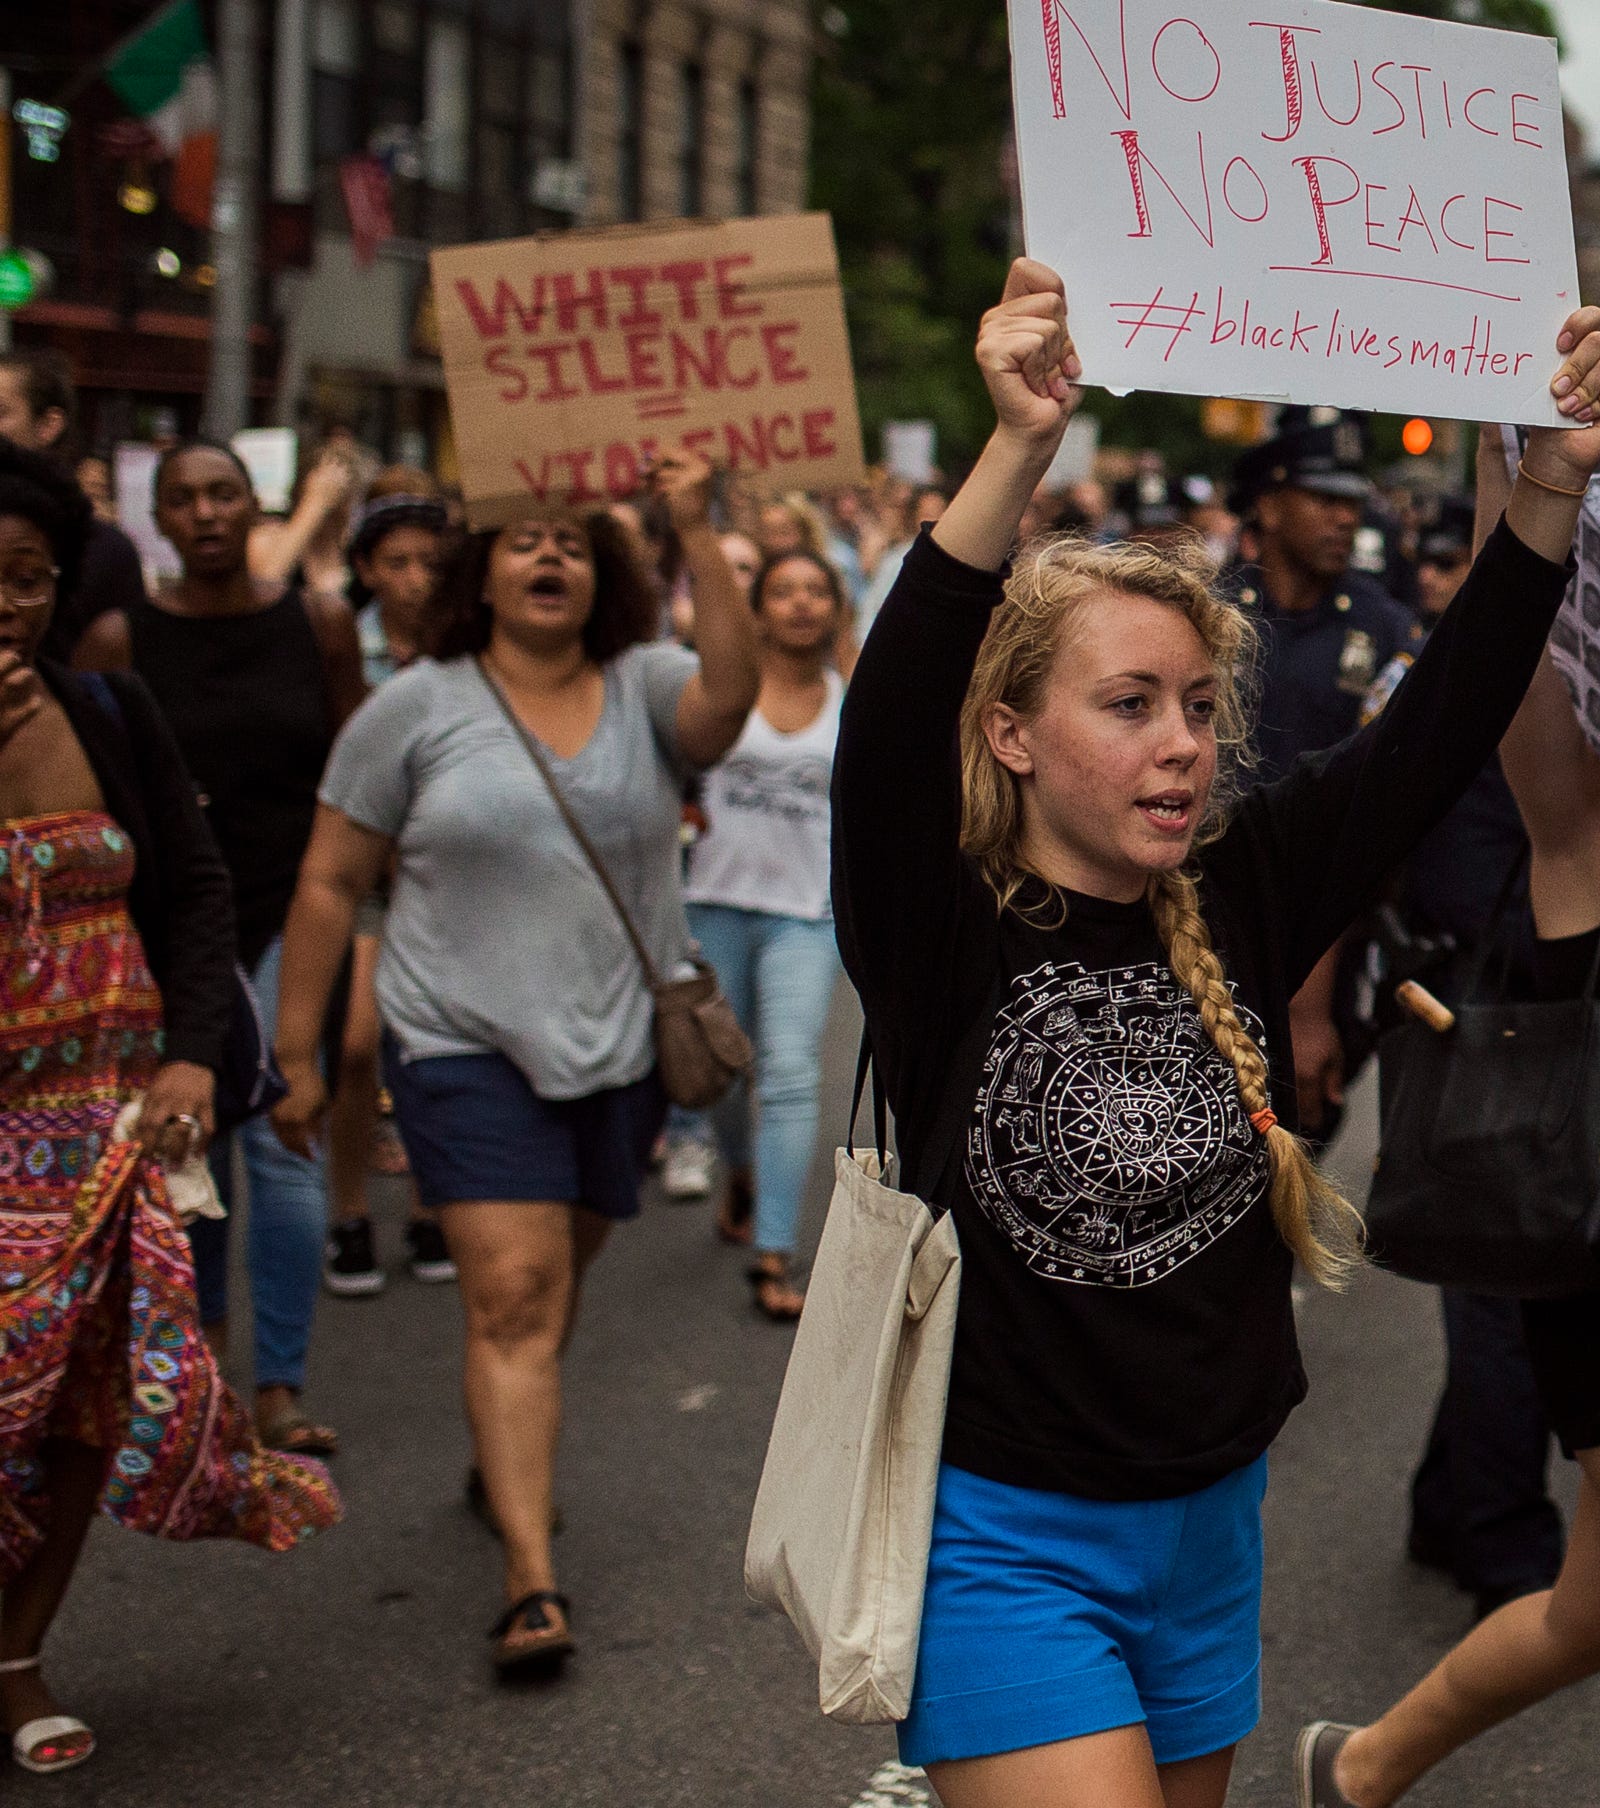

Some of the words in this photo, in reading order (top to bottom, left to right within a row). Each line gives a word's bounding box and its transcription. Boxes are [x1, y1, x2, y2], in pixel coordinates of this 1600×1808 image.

[1040, 0, 1221, 120] NO
[1249, 22, 1542, 148] JUSTICE
[1111, 130, 1268, 248] NO
[1292, 156, 1531, 264] PEACE
[455, 253, 764, 340] WHITE
[483, 322, 810, 403] SILENCE
[513, 408, 836, 505] VIOENCE
[1027, 991, 1050, 1006] Leo
